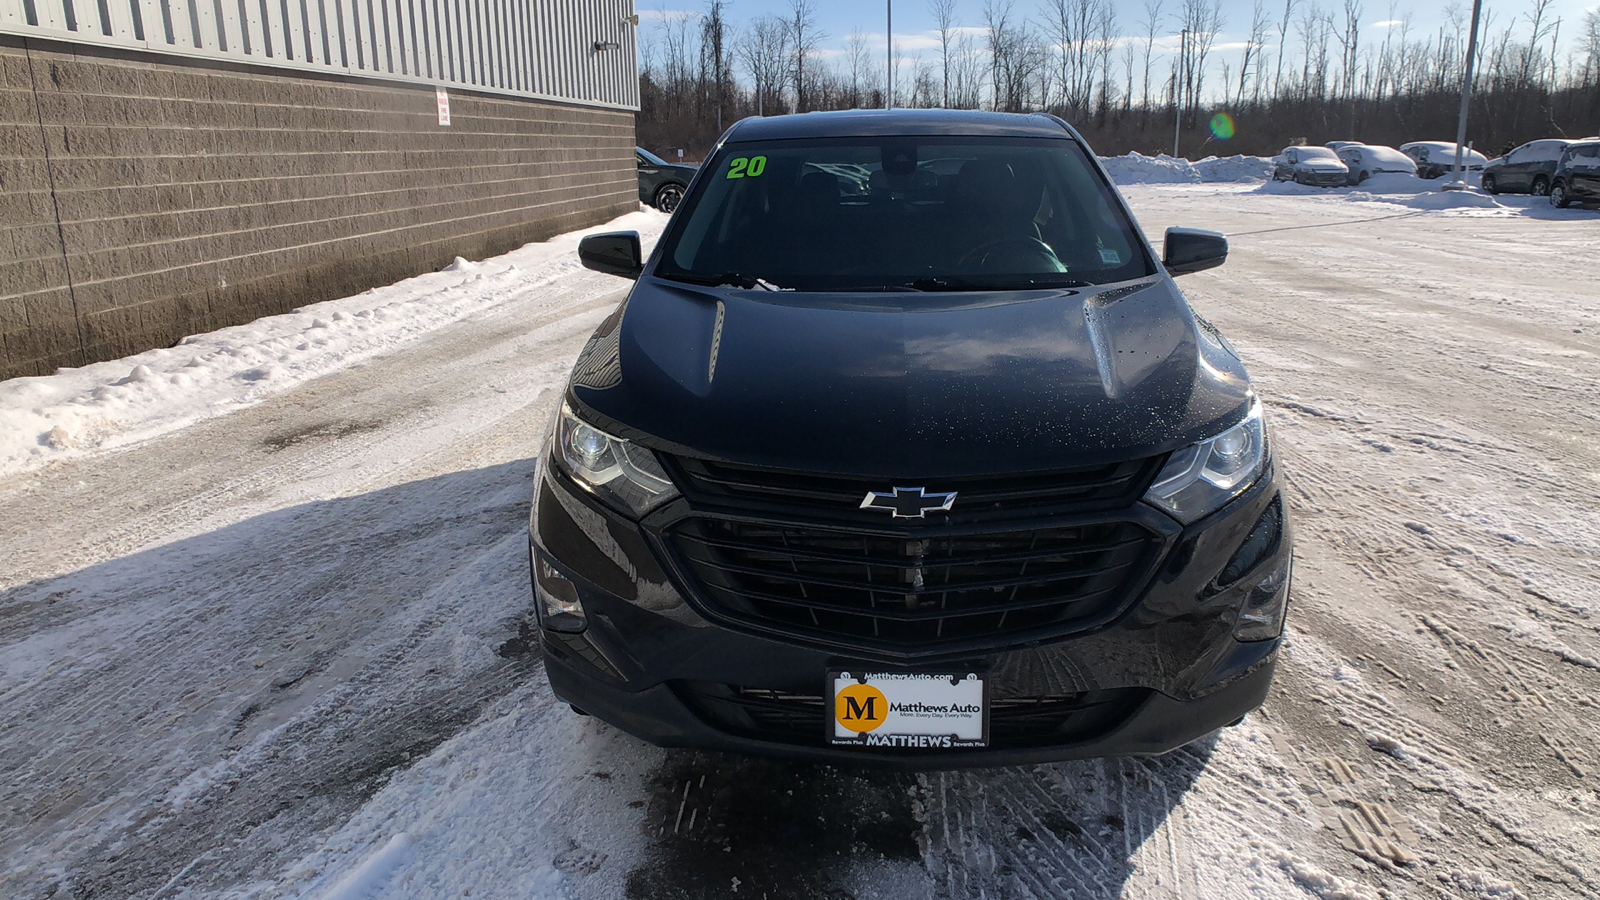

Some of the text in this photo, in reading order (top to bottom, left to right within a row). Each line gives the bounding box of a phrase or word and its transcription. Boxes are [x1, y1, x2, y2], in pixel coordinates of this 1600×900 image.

[726, 155, 767, 179] 20
[864, 672, 954, 680] MatthewsAuto.com
[842, 696, 878, 720] M
[889, 701, 980, 713] Matthews Auto
[866, 734, 952, 748] MATTHEWS
